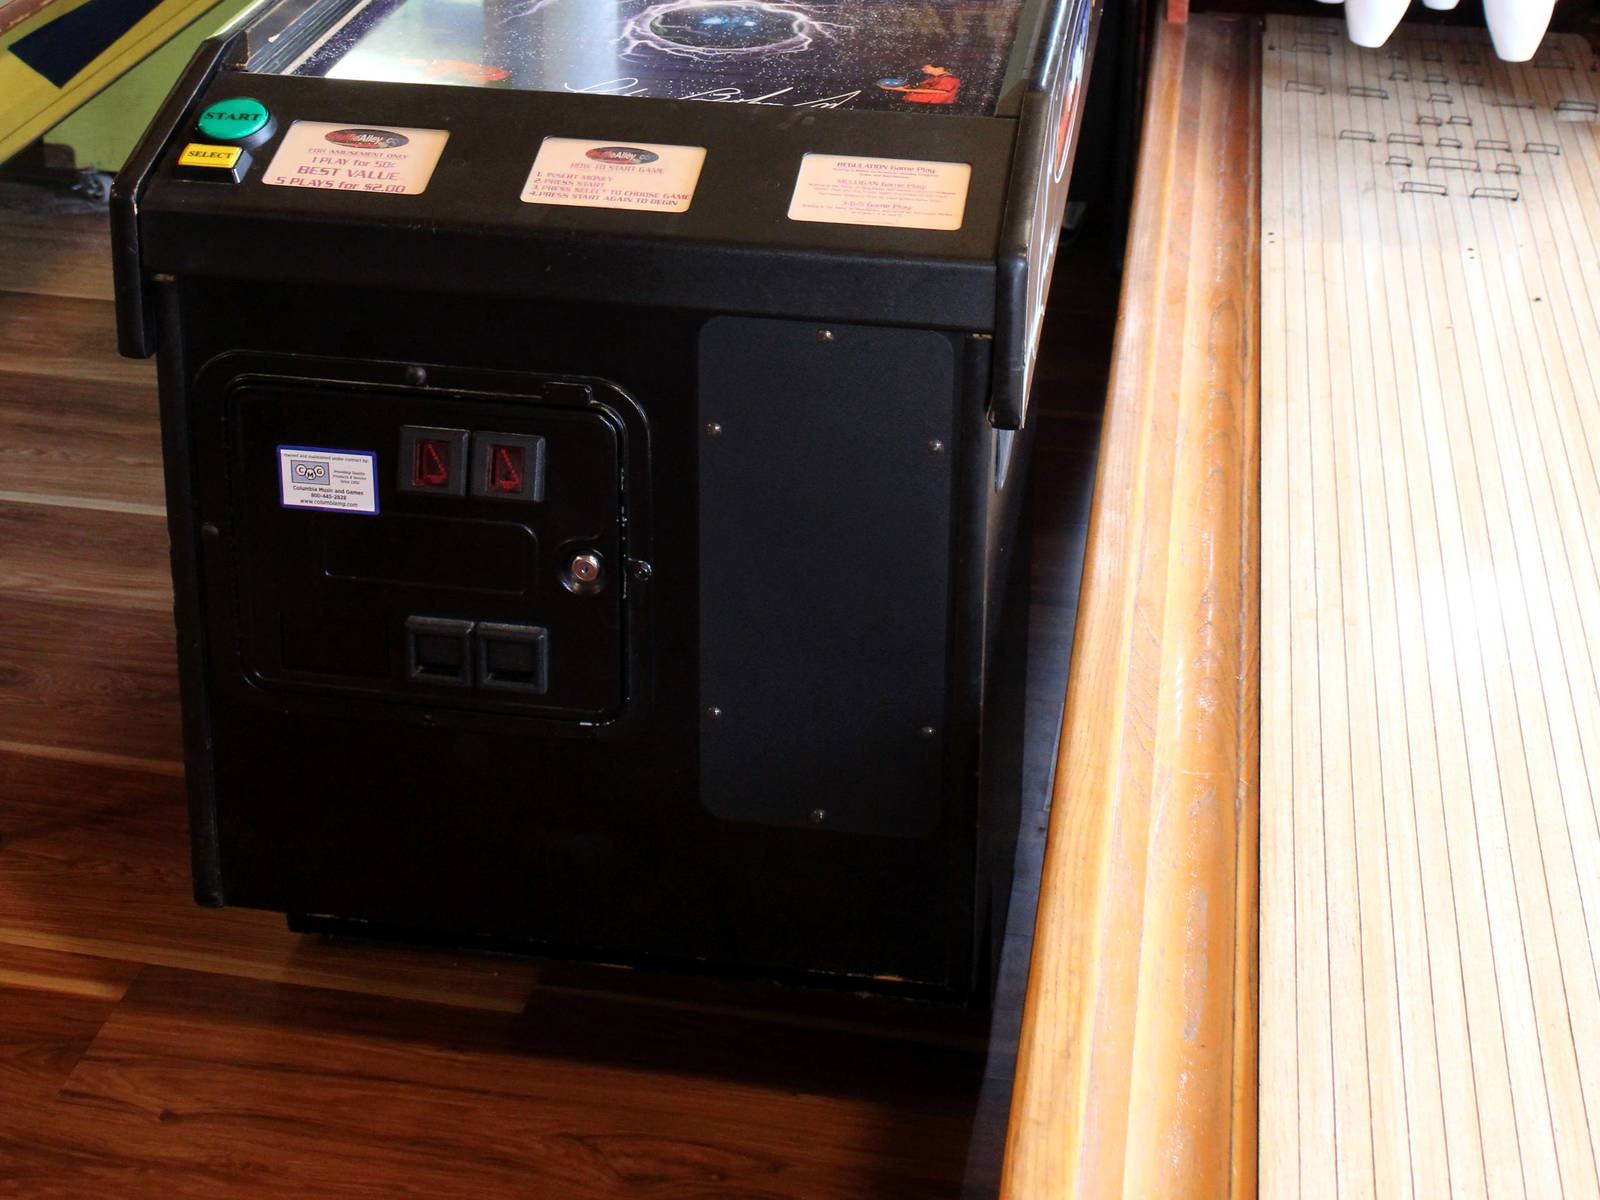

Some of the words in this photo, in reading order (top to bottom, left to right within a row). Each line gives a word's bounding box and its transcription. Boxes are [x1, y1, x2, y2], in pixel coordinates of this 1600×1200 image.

[204, 112, 263, 121] START
[187, 150, 233, 160] SELECT
[316, 157, 348, 166] PLAY
[605, 163, 636, 172] START
[296, 165, 341, 177] BEST
[346, 168, 402, 181] VALUE
[289, 177, 335, 189] PLAYS
[338, 180, 360, 190] for
[364, 183, 406, 194] $2.00
[543, 178, 574, 187] PRESS
[536, 191, 569, 200] PRESS
